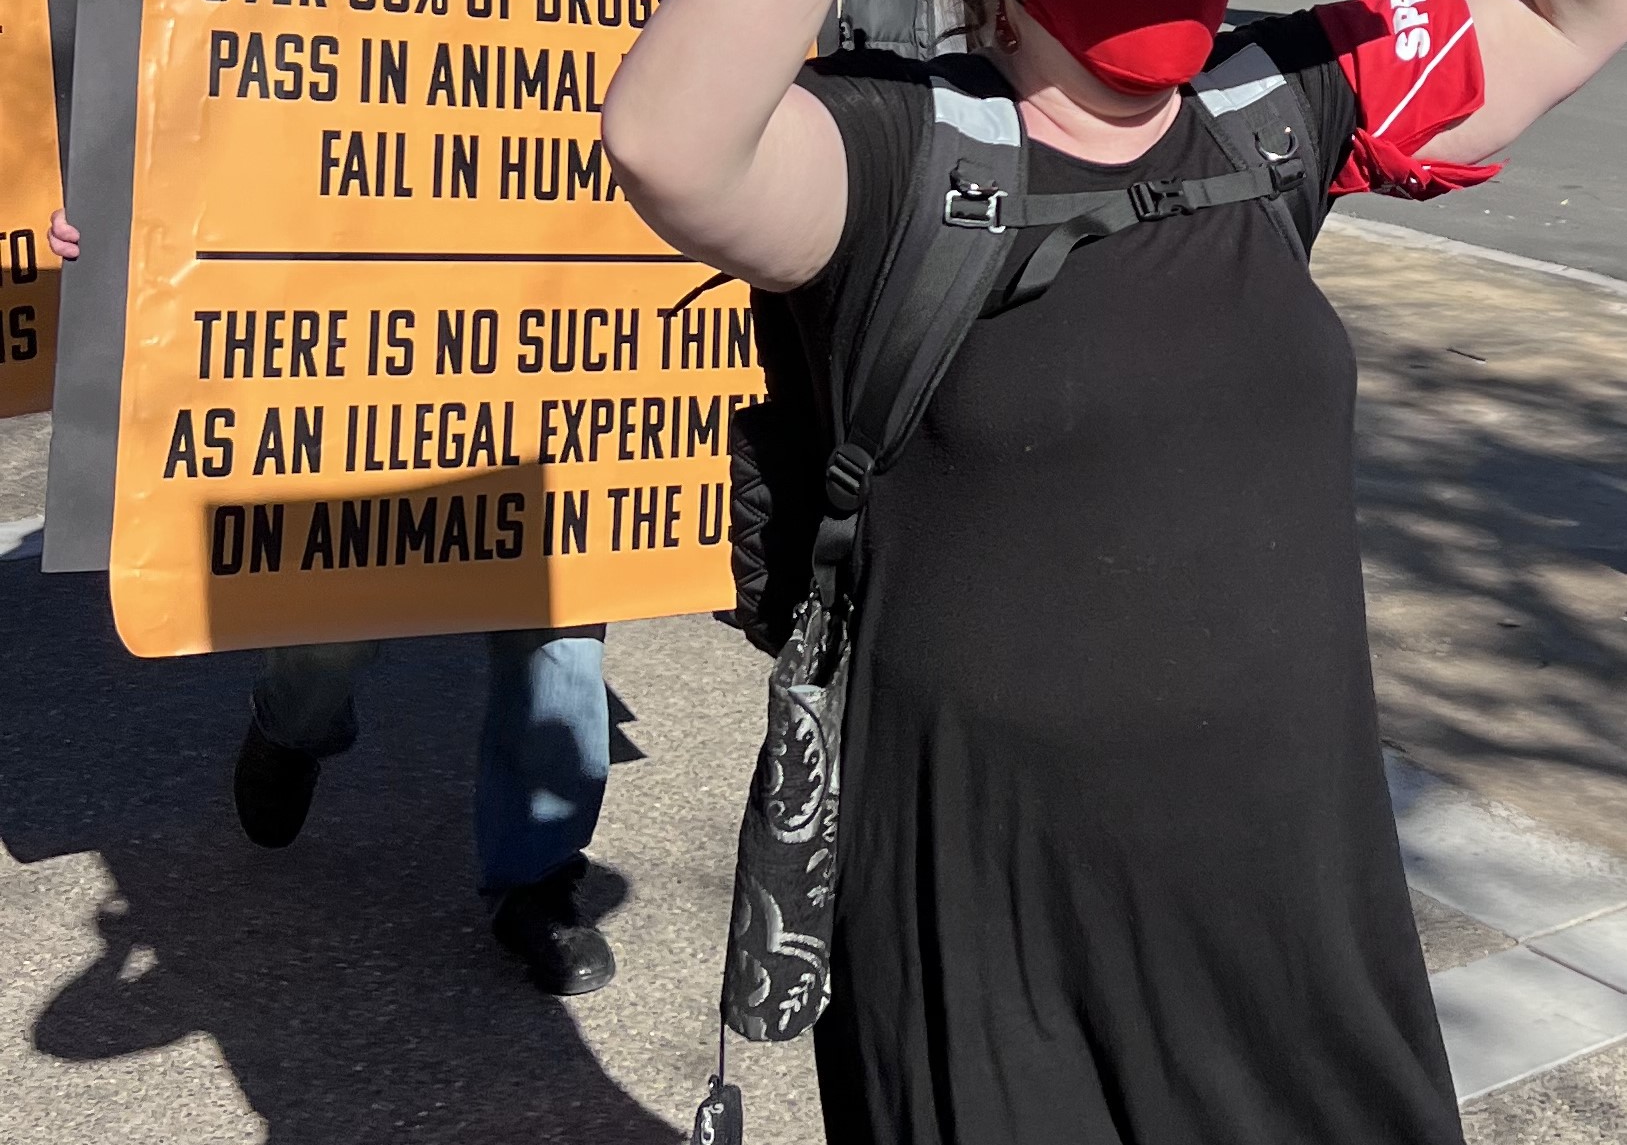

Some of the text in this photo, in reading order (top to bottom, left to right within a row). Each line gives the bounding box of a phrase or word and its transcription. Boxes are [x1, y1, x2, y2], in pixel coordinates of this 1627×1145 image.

[208, 30, 603, 113] PASS IN ANIMAL
[320, 130, 413, 198] FAIL
[432, 133, 479, 199] IN
[194, 307, 763, 380] THERE IS NO SUCH THIN
[163, 393, 772, 479] AS AN ILLEGAL EXPERIM
[211, 483, 734, 576] ON ANIMALS IN THE U
